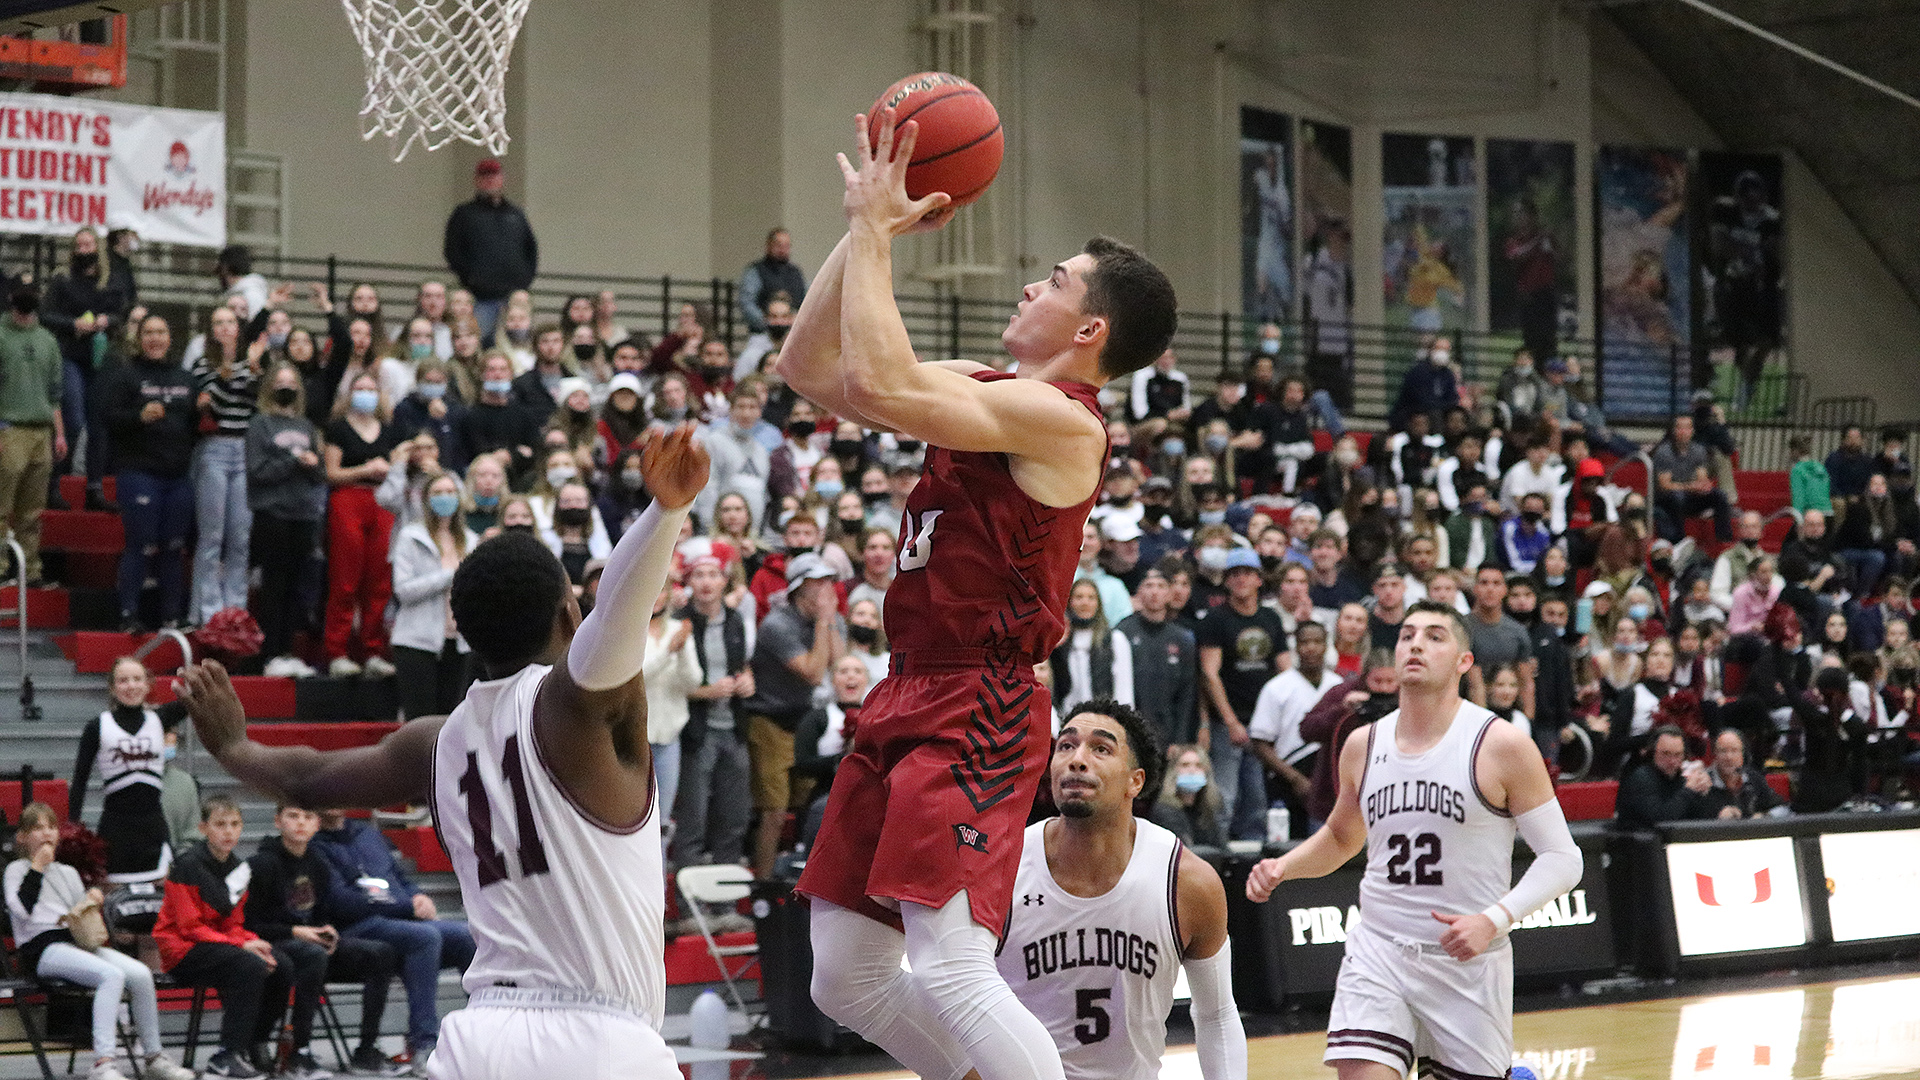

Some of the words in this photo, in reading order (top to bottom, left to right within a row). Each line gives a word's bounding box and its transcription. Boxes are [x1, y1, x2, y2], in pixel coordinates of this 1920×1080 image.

[0, 149, 109, 185] TUDENT
[0, 188, 106, 226] ECTION
[458, 733, 550, 888] 11
[1367, 780, 1466, 828] BULLDOGS
[1386, 832, 1443, 886] 22
[1288, 905, 1362, 946] PIRA
[1022, 927, 1159, 981] BULLDOGS
[1074, 988, 1112, 1046] 5
